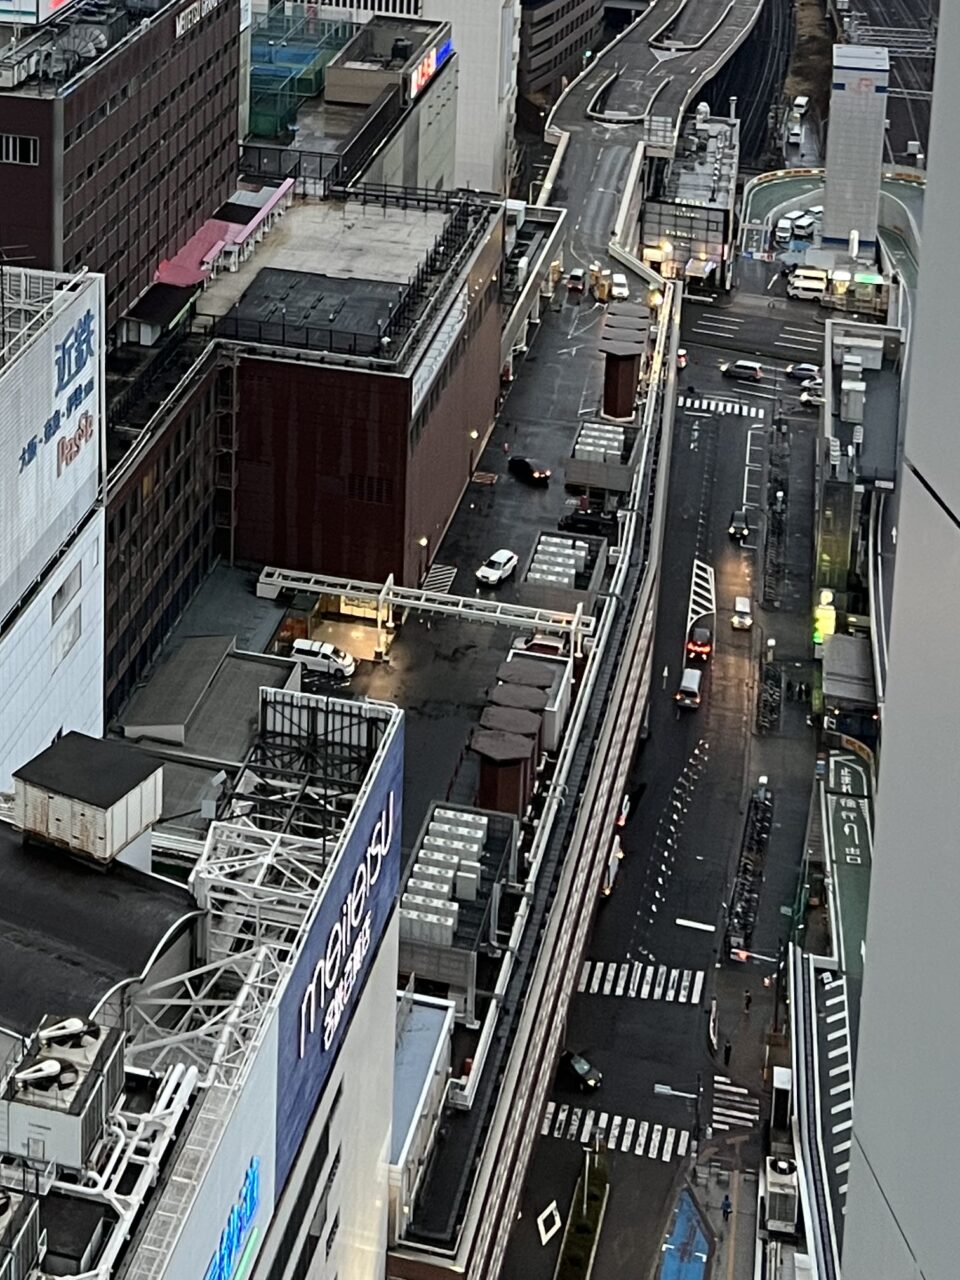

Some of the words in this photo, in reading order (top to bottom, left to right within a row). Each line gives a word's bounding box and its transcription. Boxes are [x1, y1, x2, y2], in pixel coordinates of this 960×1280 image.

[55, 308, 95, 398] 近鉄
[840, 767, 853, 794] 止まれ
[840, 798, 858, 821] 徐行
[845, 847, 862, 865] 出口
